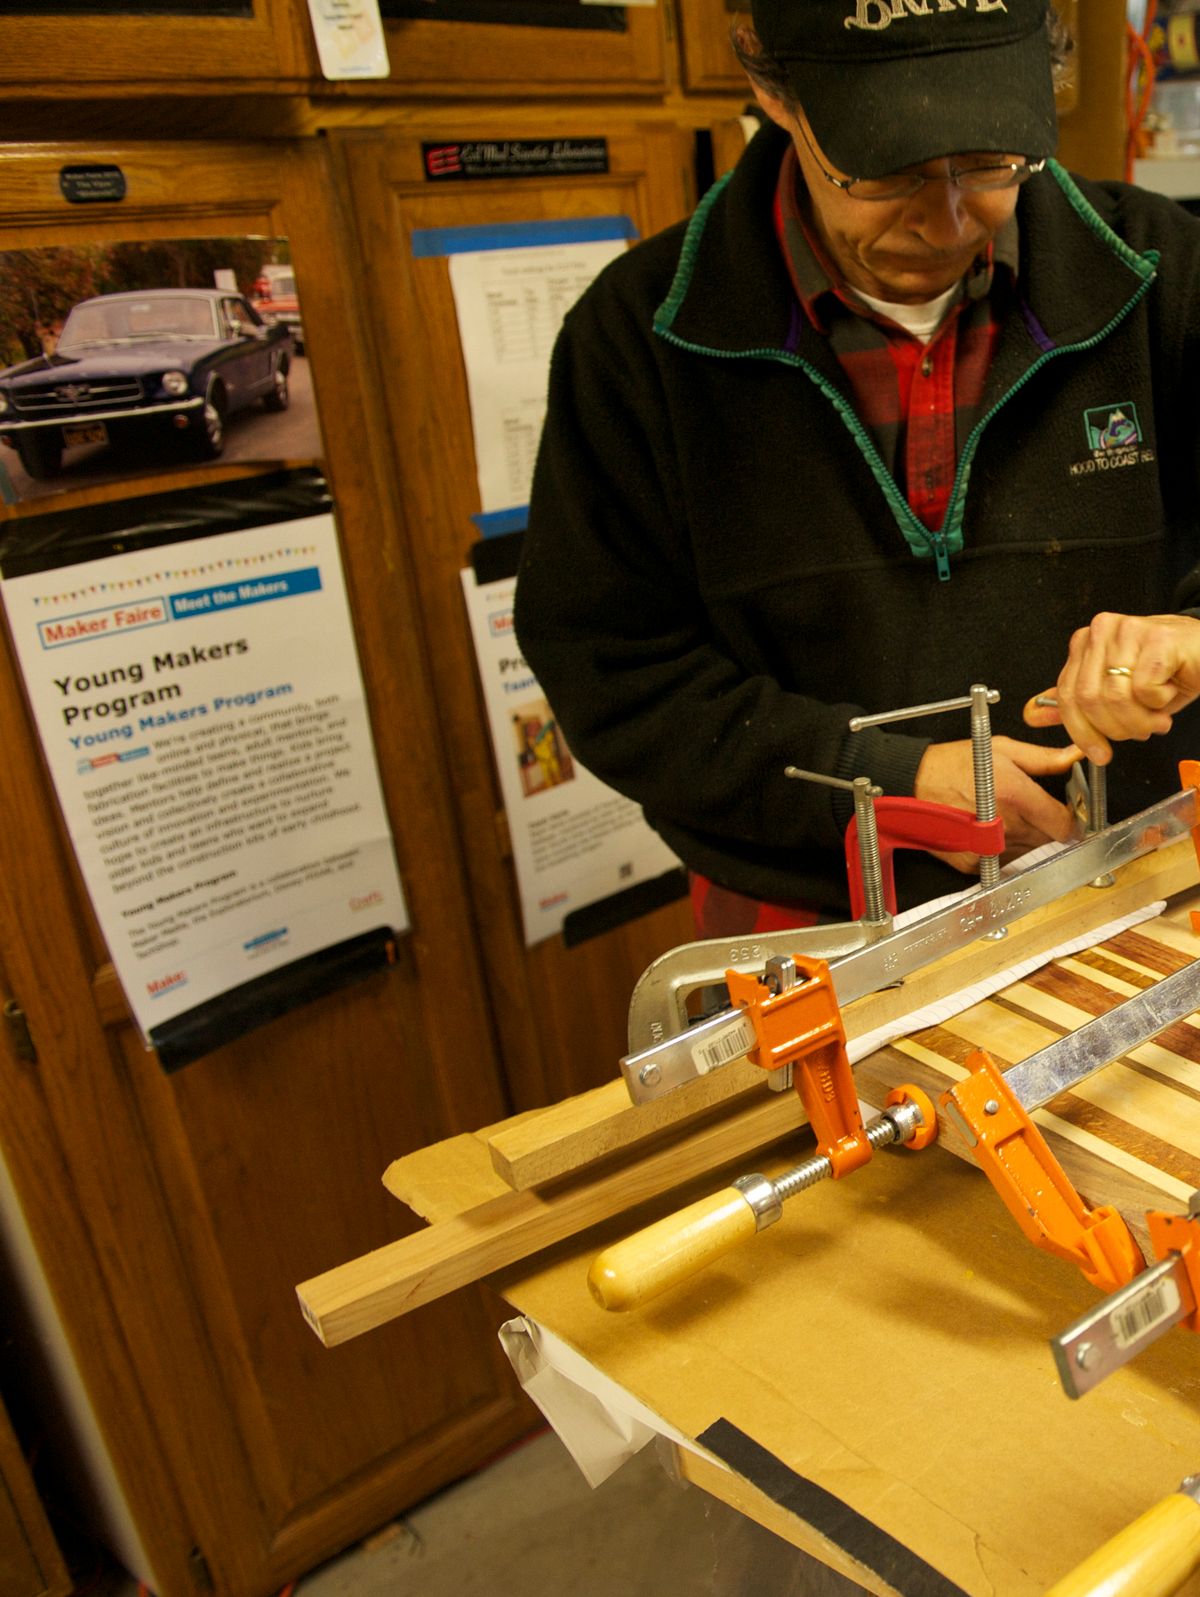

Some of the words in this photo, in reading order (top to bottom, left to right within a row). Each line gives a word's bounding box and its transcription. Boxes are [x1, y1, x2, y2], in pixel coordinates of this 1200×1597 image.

[1095, 457, 1111, 470] TO
[1110, 452, 1139, 468] COAST
[174, 595, 210, 612] Meet
[213, 591, 237, 604] the
[239, 581, 287, 598] Makers
[46, 619, 106, 641] Maker
[114, 608, 161, 626] Faire
[55, 665, 143, 695] Young
[153, 640, 247, 671] Makers
[64, 685, 180, 725] Program
[70, 725, 133, 748] Young
[140, 706, 207, 730] Makers
[214, 685, 292, 710] Program
[328, 718, 346, 729] and
[196, 740, 215, 751] and
[243, 767, 262, 779] and
[219, 801, 237, 813] and
[134, 814, 153, 827] and
[167, 846, 185, 859] and
[123, 903, 154, 917] Young
[156, 888, 192, 903] Makers
[195, 871, 236, 889] Program
